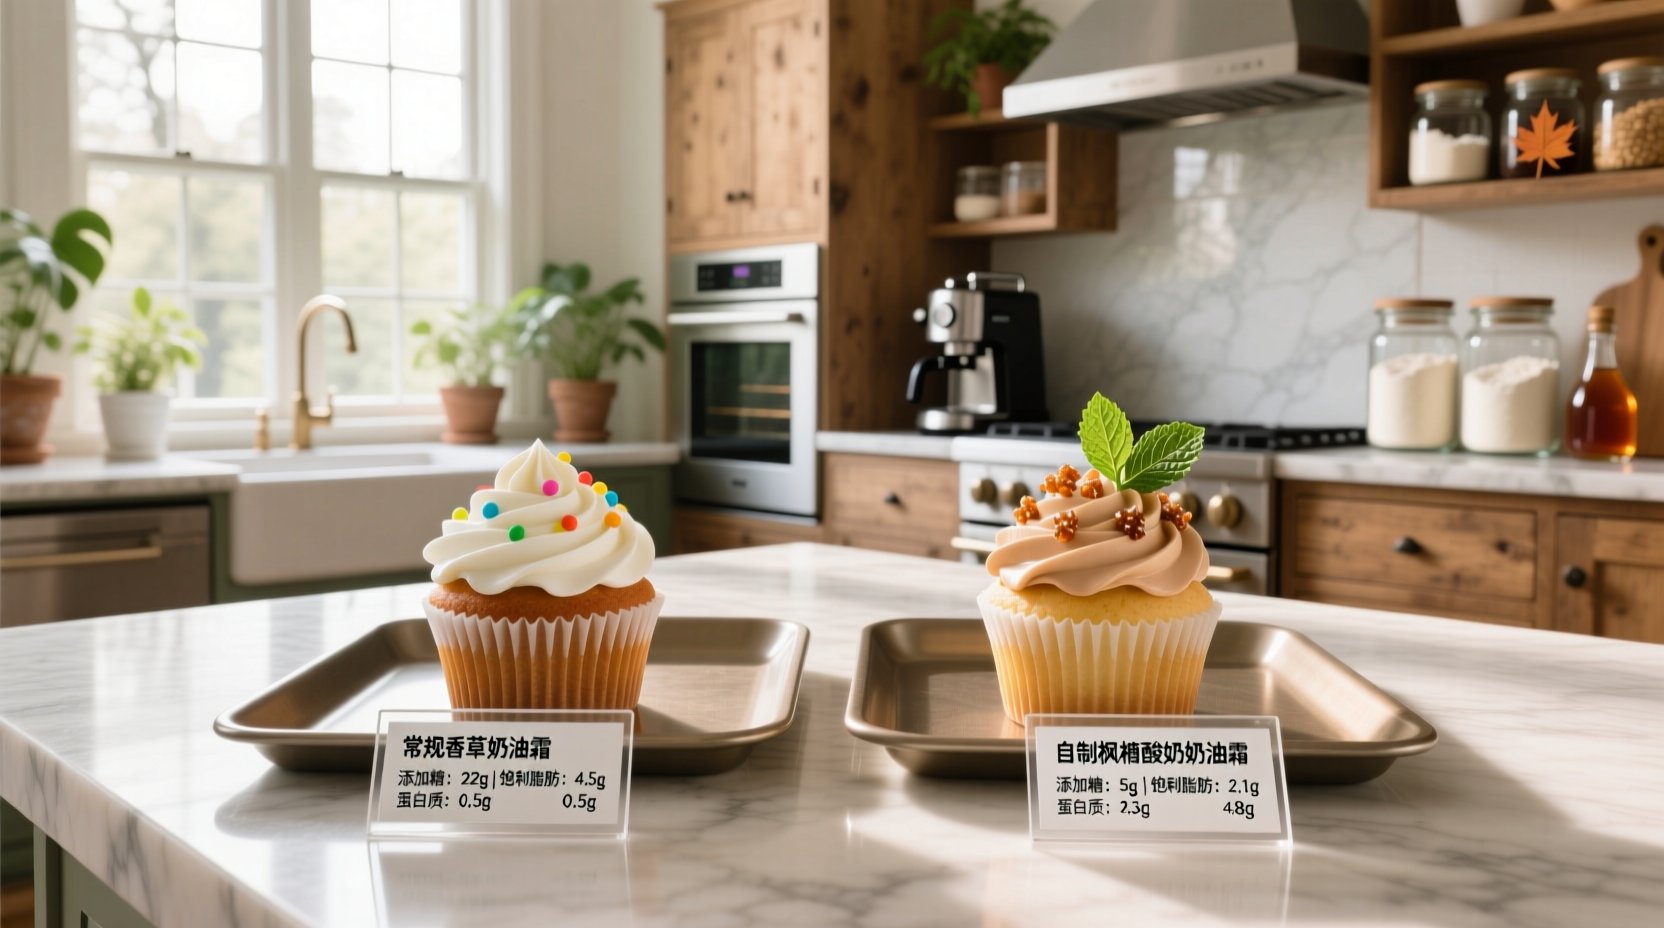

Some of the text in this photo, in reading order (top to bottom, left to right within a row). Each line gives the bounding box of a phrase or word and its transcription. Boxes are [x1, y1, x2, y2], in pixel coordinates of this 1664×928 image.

[402, 734, 552, 760] 常规香草奶油霜
[460, 771, 488, 789] 22g
[574, 771, 606, 790] 4.5g
[1119, 777, 1138, 797] 5g
[1228, 778, 1260, 797] 2.1g
[458, 793, 492, 811] 0.5g
[562, 793, 597, 812] 0.5g
[1120, 800, 1150, 819] 2.3g
